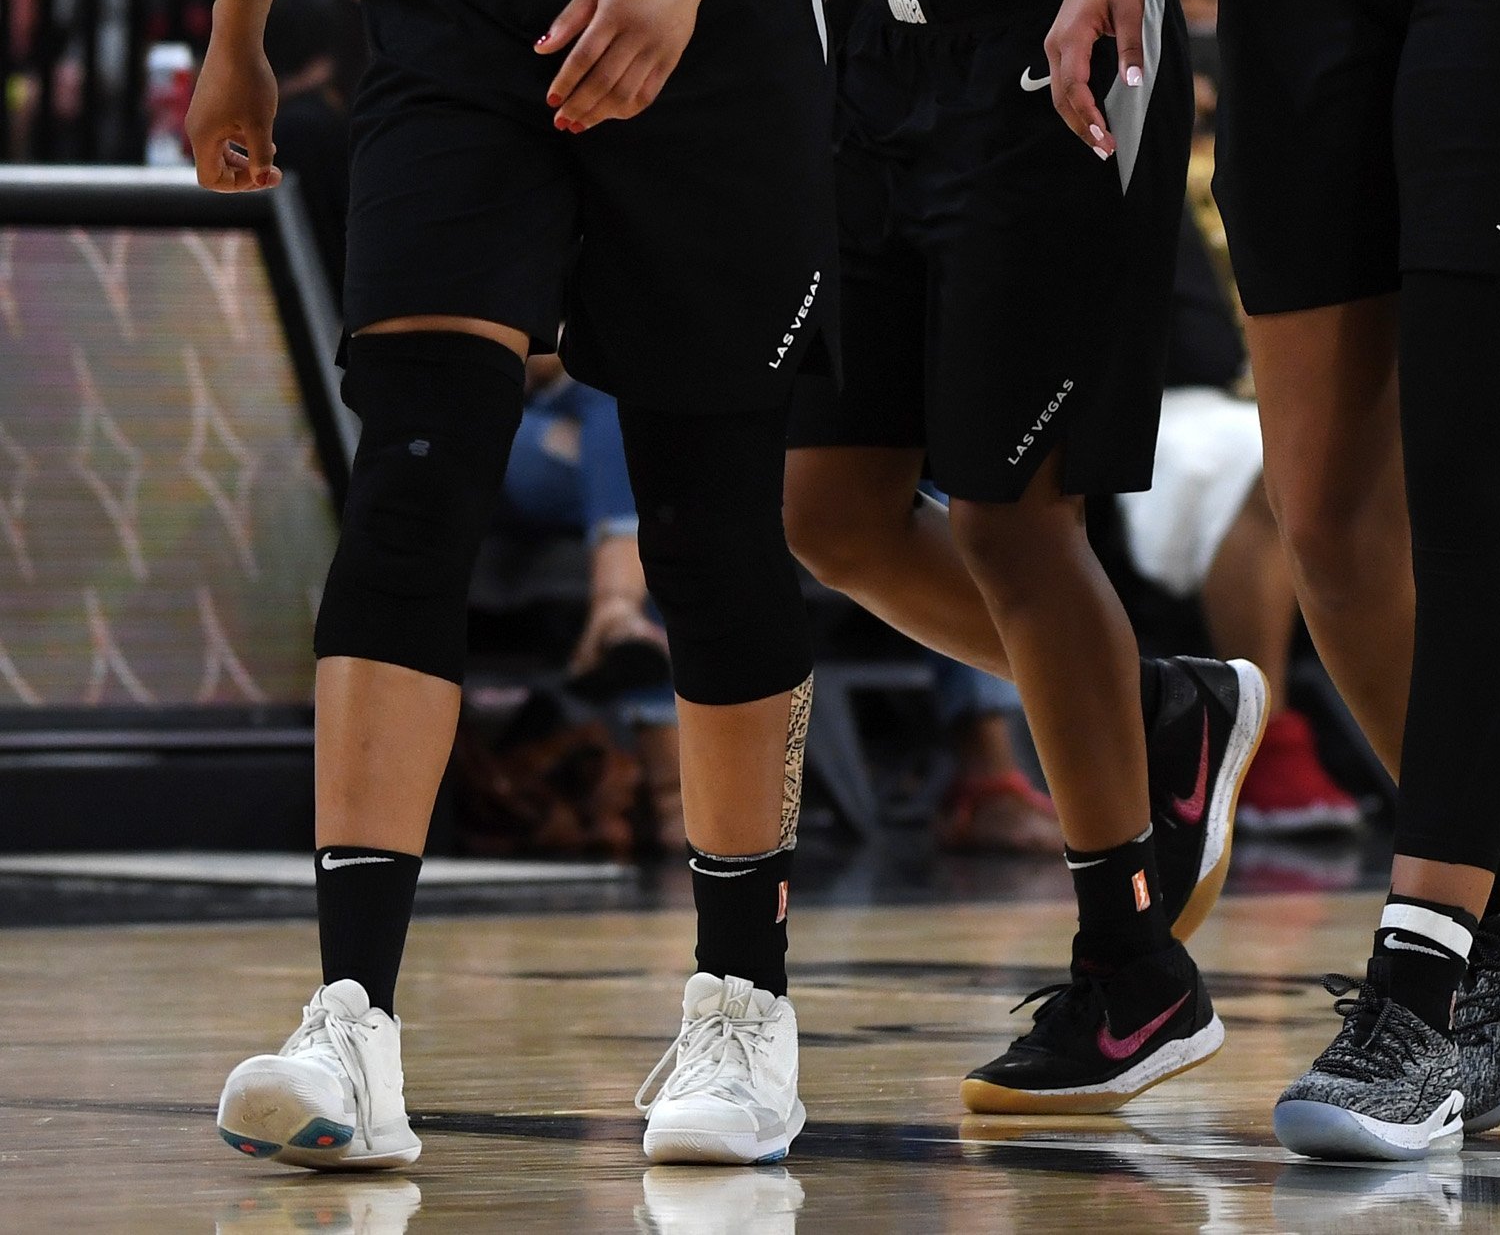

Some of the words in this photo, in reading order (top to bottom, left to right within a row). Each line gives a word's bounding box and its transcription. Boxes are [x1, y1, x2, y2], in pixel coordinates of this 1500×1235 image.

[769, 333, 794, 369] LAS
[791, 270, 821, 329] VEGAS
[1008, 434, 1033, 465] LAS
[1032, 379, 1074, 431] VEGAS
